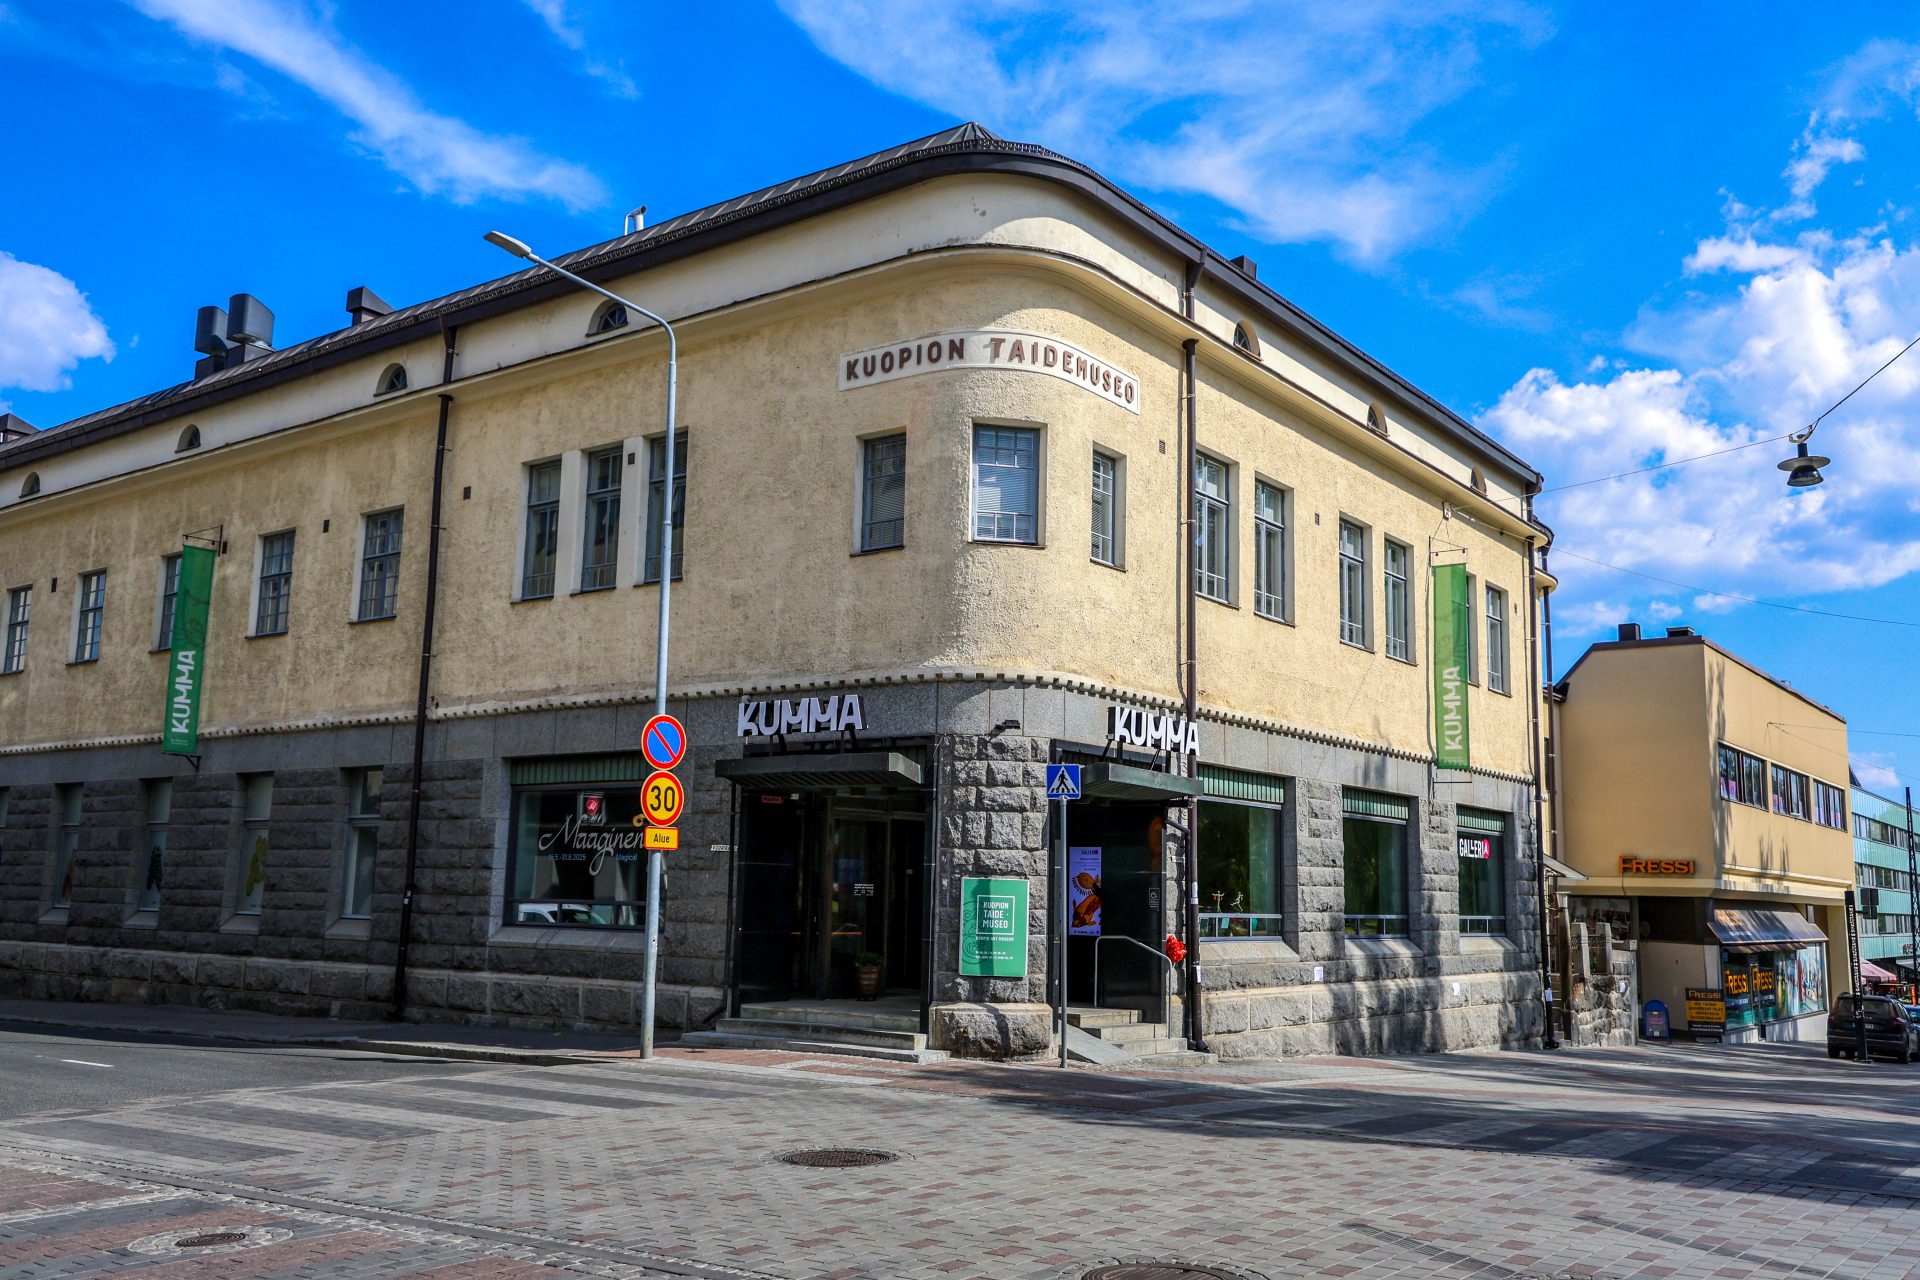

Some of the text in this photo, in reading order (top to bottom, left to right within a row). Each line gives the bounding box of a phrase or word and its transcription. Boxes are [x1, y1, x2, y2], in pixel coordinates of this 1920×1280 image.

[846, 337, 1135, 404] KUOPION TAIDEMUSEO
[171, 650, 196, 733] KUMMA
[737, 694, 863, 737] KUMMA
[1442, 666, 1463, 751] KUMMA
[1114, 705, 1200, 756] KUMMA
[649, 785, 676, 812] 30
[539, 814, 645, 876] Maaginen
[653, 833, 670, 844] Alue
[1459, 838, 1490, 859] GALLERIA
[616, 853, 638, 863] Magical
[983, 901, 1009, 909] KUOPION
[983, 909, 1004, 919] TAIDE
[982, 920, 1009, 929] MUSEO
